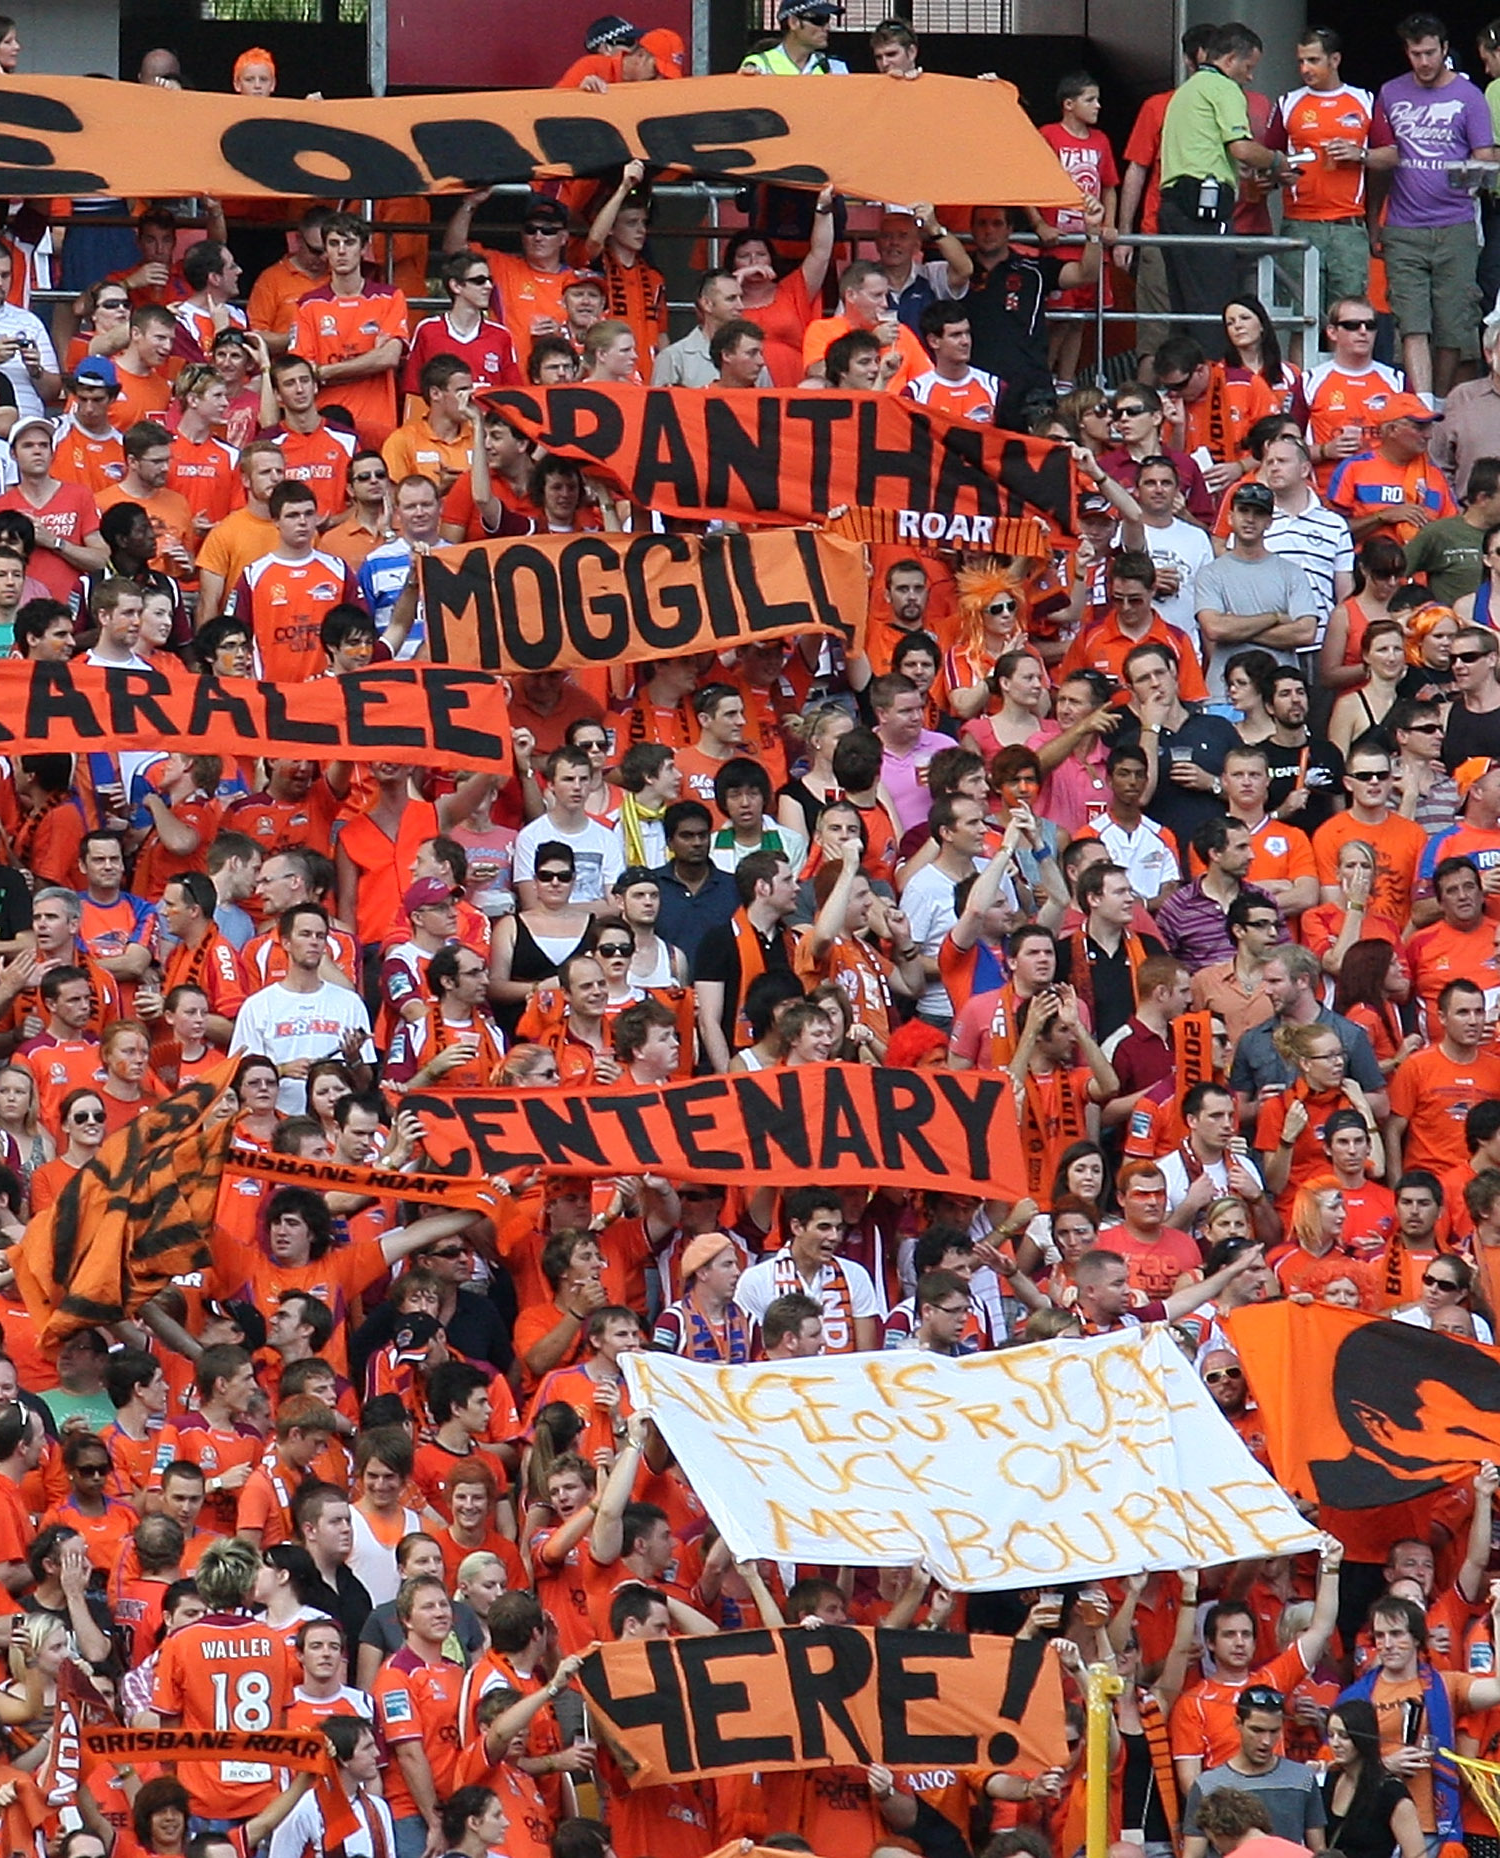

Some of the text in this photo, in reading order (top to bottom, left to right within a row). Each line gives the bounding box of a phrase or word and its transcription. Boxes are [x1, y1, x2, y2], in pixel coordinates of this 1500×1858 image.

[220, 108, 828, 199] ONE
[898, 508, 993, 545] ROAR
[422, 529, 854, 669] MOGGILL
[398, 1066, 1004, 1181] CENTENARY
[226, 1148, 449, 1197] RISBANE ROAR
[634, 1357, 837, 1440] ANGE
[864, 1361, 953, 1409] IS
[713, 1432, 1174, 1501] FUCK OFF
[200, 1639, 270, 1666] WALLER
[211, 1671, 271, 1732] 18
[579, 1625, 1047, 1773] HERE!
[86, 1732, 322, 1761] BRISBANE ROAR
